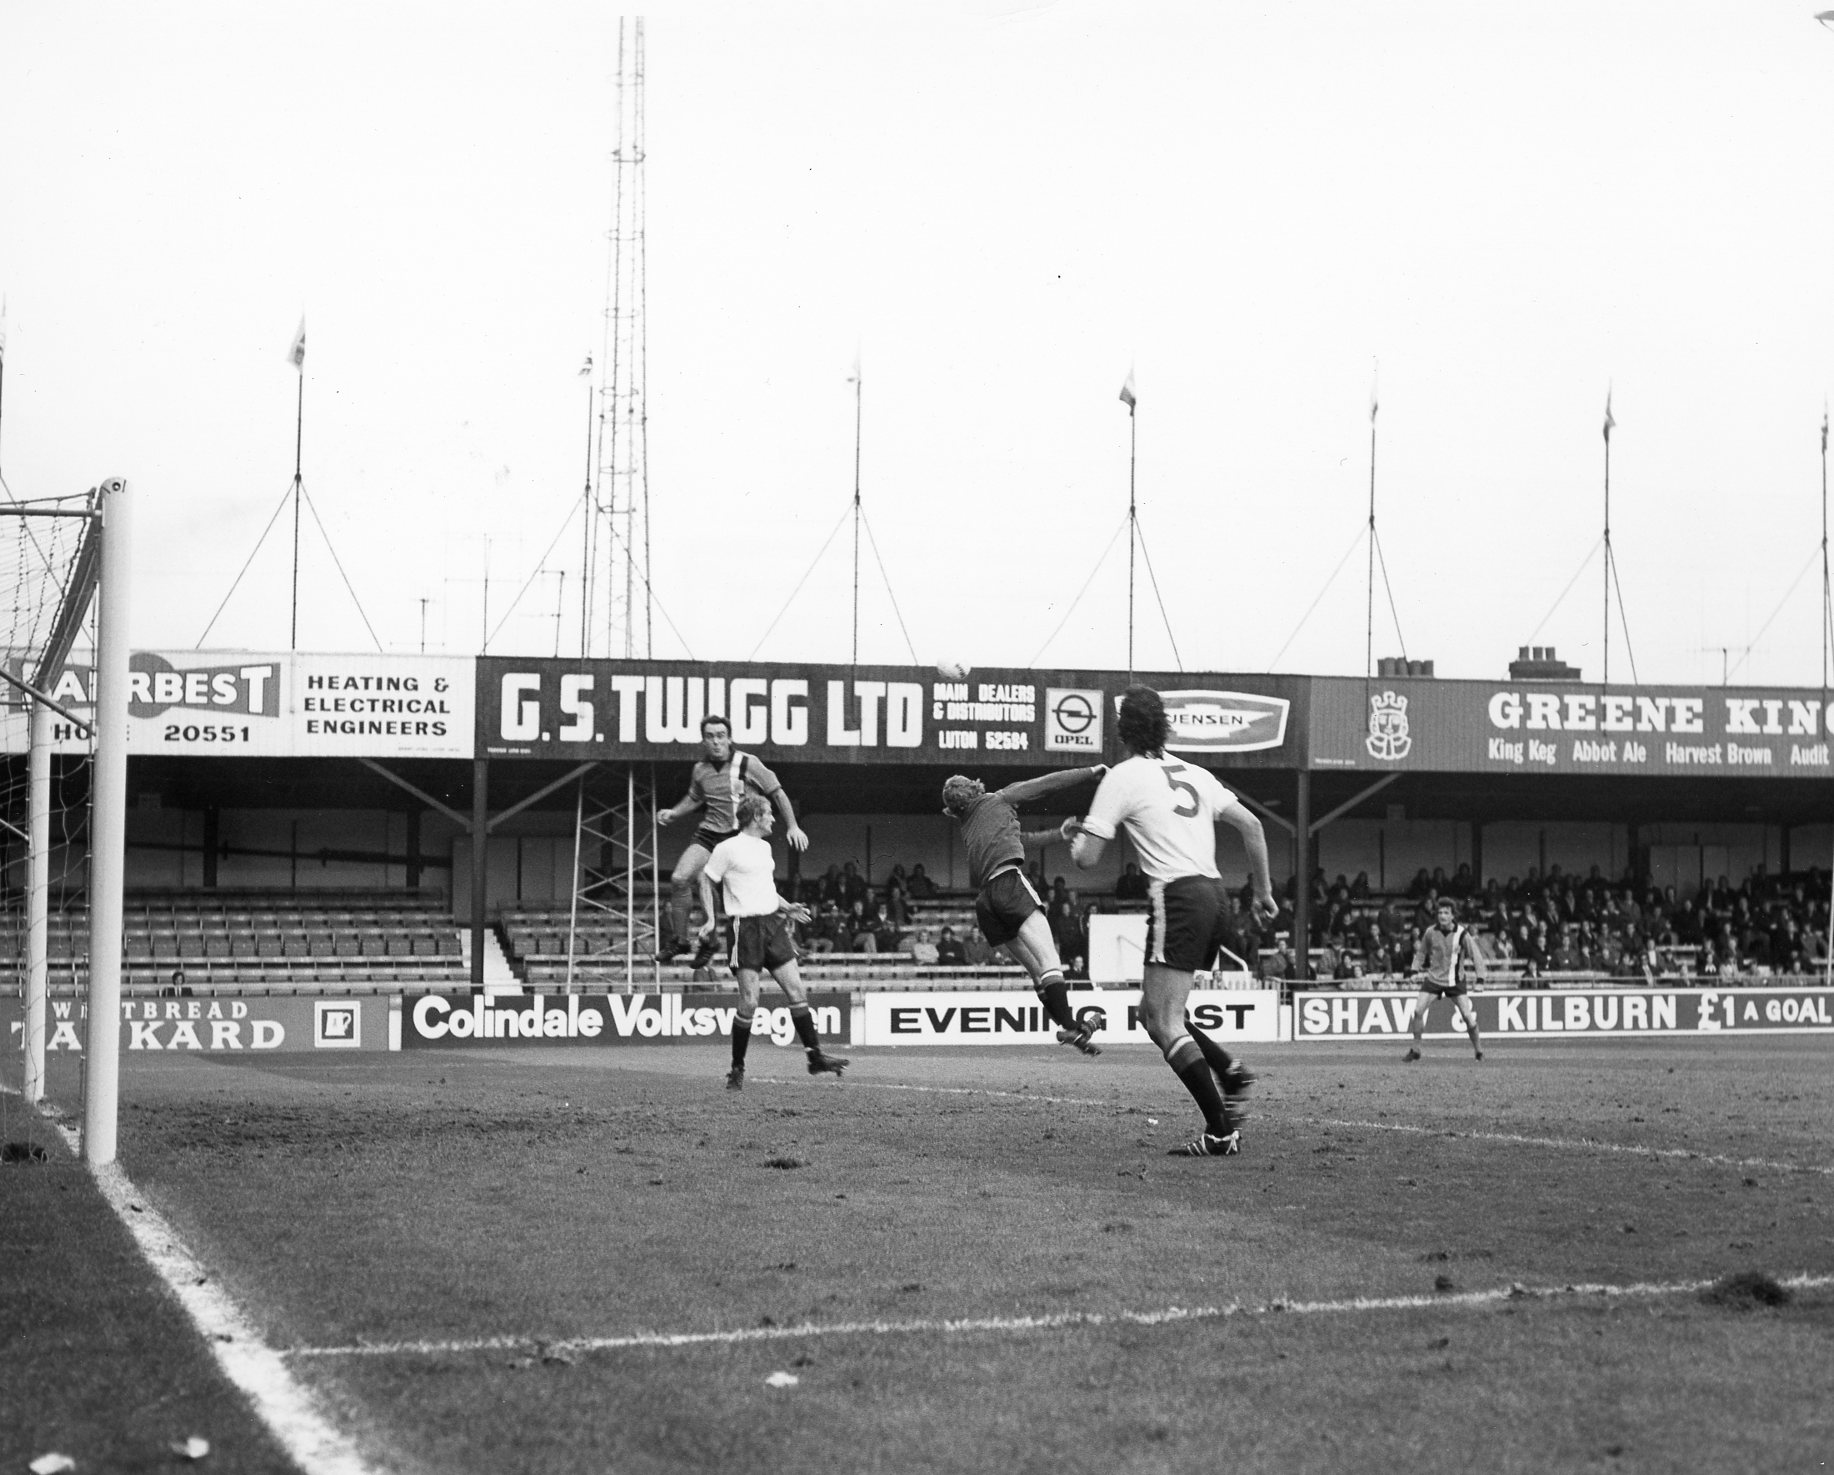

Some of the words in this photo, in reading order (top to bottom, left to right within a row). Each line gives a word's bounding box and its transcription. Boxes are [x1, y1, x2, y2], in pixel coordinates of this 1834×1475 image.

[308, 675, 419, 692] HEATING
[434, 677, 449, 692] &
[933, 683, 968, 701] MAIN
[979, 683, 1035, 703] DEALERS
[304, 697, 451, 713] ELECTRICAL
[827, 680, 923, 748] LTD
[933, 701, 944, 720] &
[947, 702, 1035, 722] DISTRIBUTORS
[1488, 692, 1703, 733] GREENE
[307, 720, 447, 736] ENGINEERS
[1166, 714, 1243, 725] JENSEN
[164, 724, 249, 742] 20551
[939, 730, 978, 749] LUTON
[1055, 734, 1093, 744] OPEL
[1489, 738, 1524, 764] King
[1529, 739, 1556, 765] Keg
[1573, 740, 1616, 762] Abbot
[1623, 741, 1647, 763] Ale
[1666, 742, 1722, 764] Harvest
[1728, 742, 1772, 764] Brown
[1790, 744, 1830, 765] Audit
[1161, 765, 1200, 818] 5
[413, 994, 603, 1039] Colindale
[1303, 997, 1429, 1033] SHAW
[1498, 995, 1677, 1031] KILBURN
[1698, 991, 1735, 1030] £1
[1743, 1000, 1759, 1021] A
[1765, 996, 1832, 1023] GOAL
